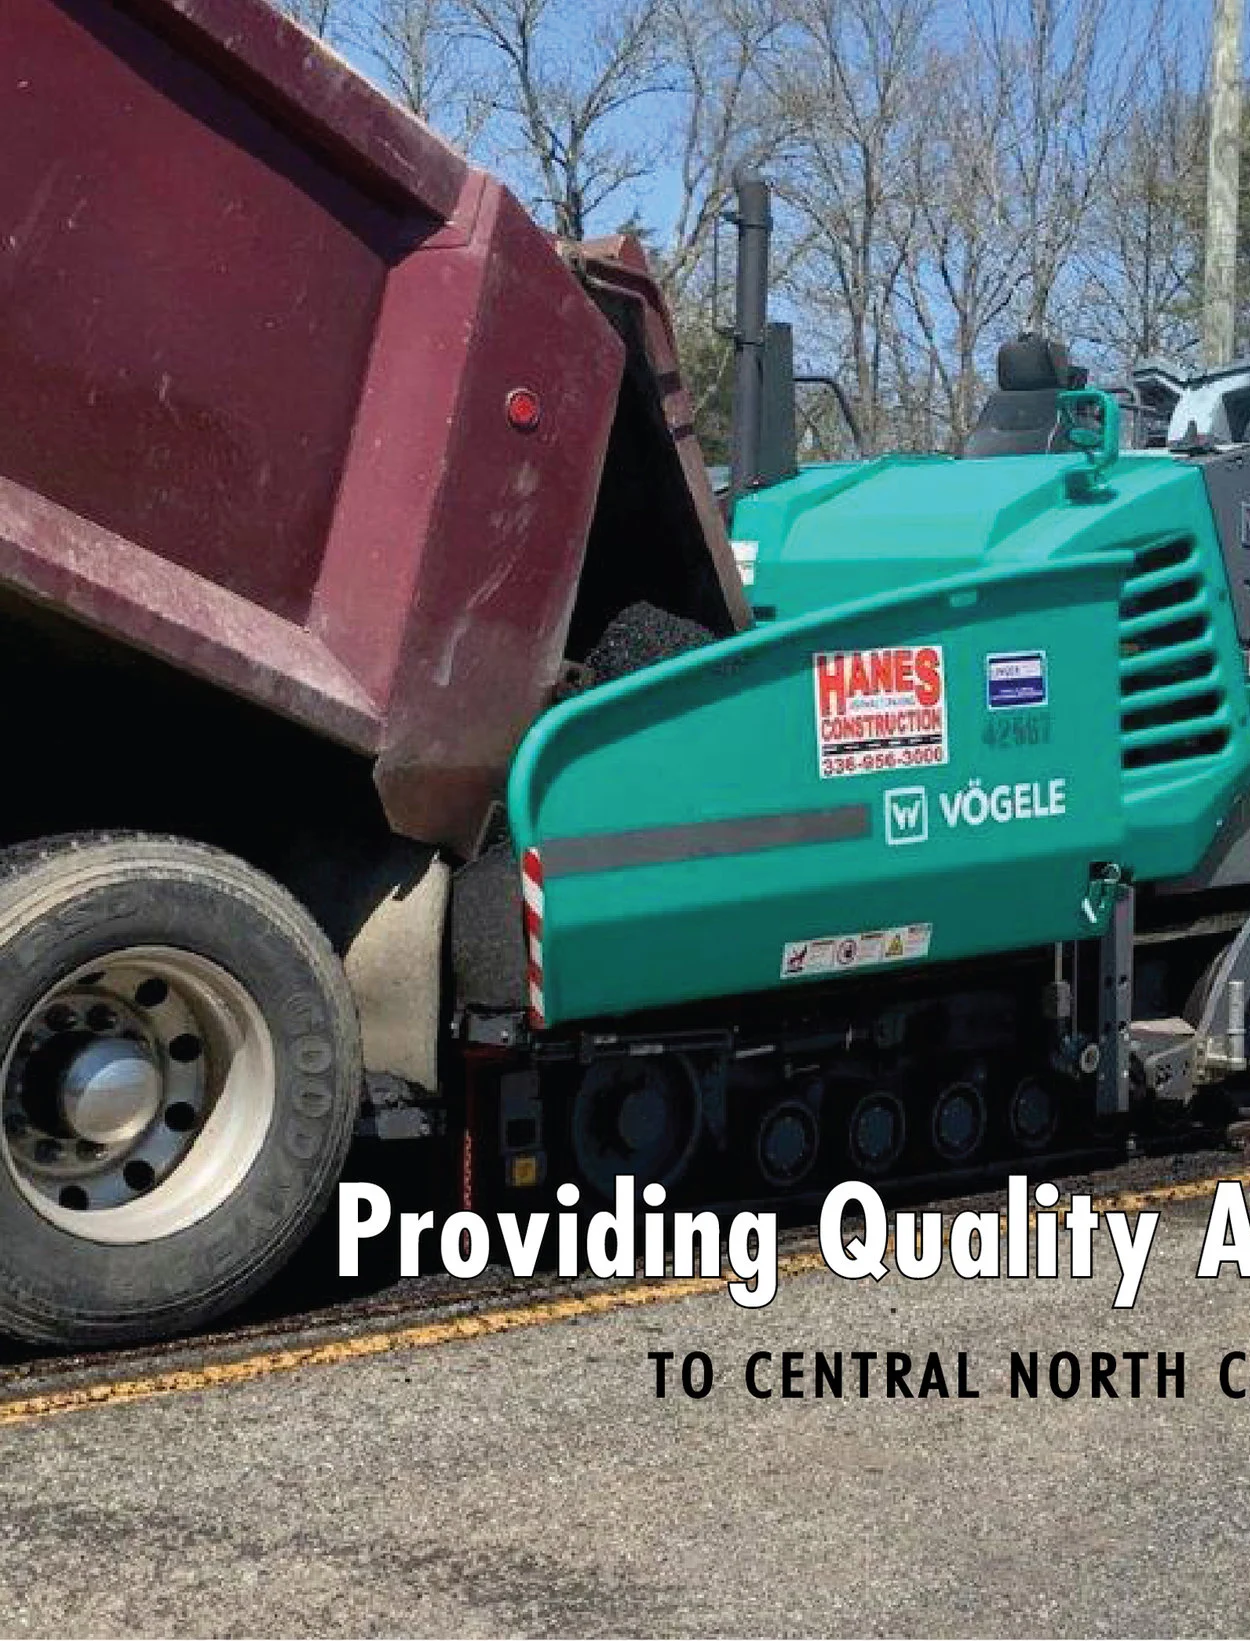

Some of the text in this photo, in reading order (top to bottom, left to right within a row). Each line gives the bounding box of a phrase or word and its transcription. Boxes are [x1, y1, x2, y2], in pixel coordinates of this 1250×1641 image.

[818, 648, 941, 717] HANES
[822, 708, 942, 742] CONSTRUCTION
[939, 778, 1066, 827] VÖGELE
